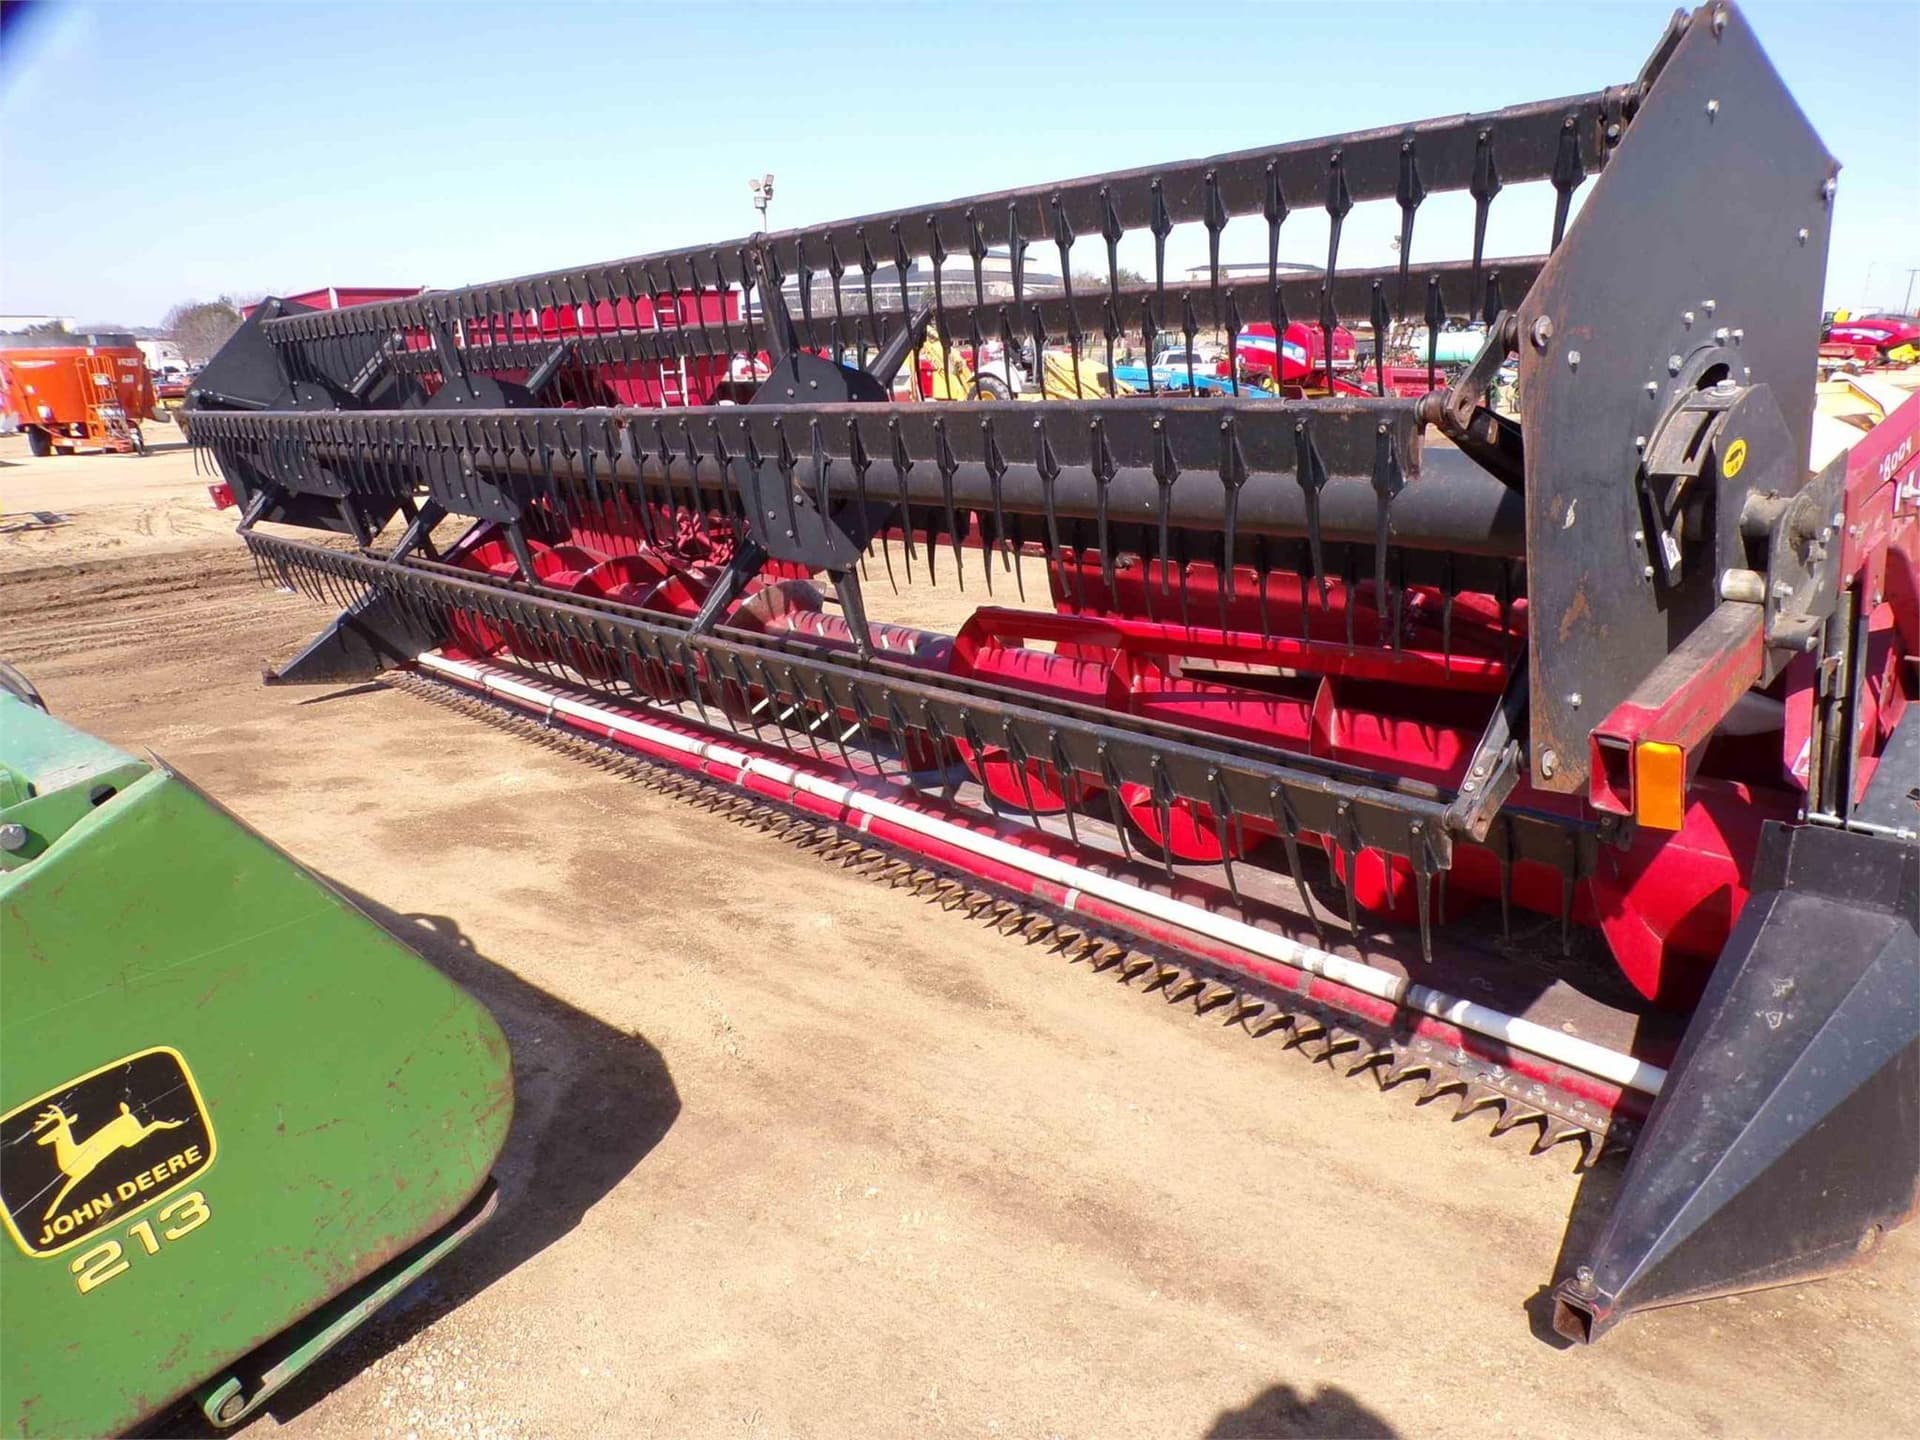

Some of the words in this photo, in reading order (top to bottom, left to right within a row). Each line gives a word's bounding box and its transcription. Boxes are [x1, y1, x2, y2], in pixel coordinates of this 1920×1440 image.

[39, 1192, 113, 1245] JOHN
[116, 1144, 203, 1201] DEERE
[70, 1191, 211, 1294] 213
